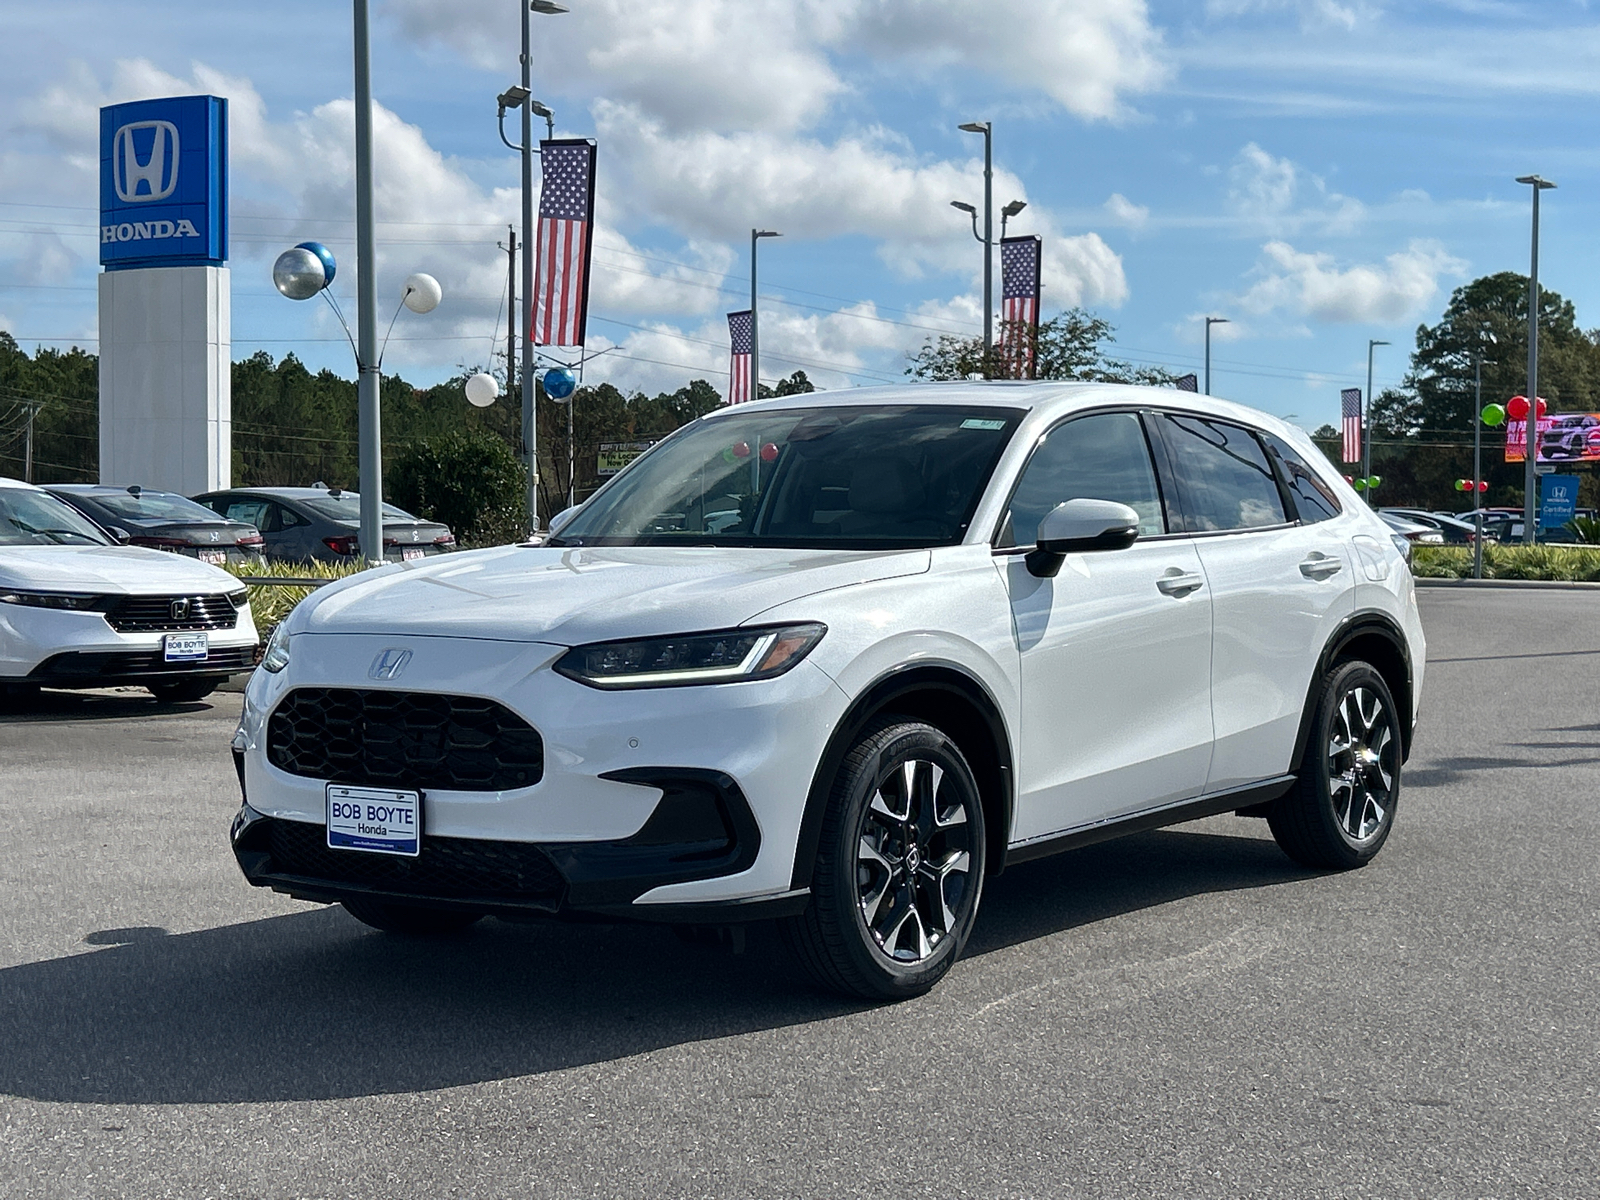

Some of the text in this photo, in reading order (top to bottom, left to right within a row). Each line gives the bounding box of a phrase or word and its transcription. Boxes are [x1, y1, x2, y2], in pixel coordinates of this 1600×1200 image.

[101, 219, 200, 243] HONDA
[1543, 505, 1572, 513] Certified
[332, 802, 414, 825] BOB BOYTE
[357, 822, 388, 836] Honda
